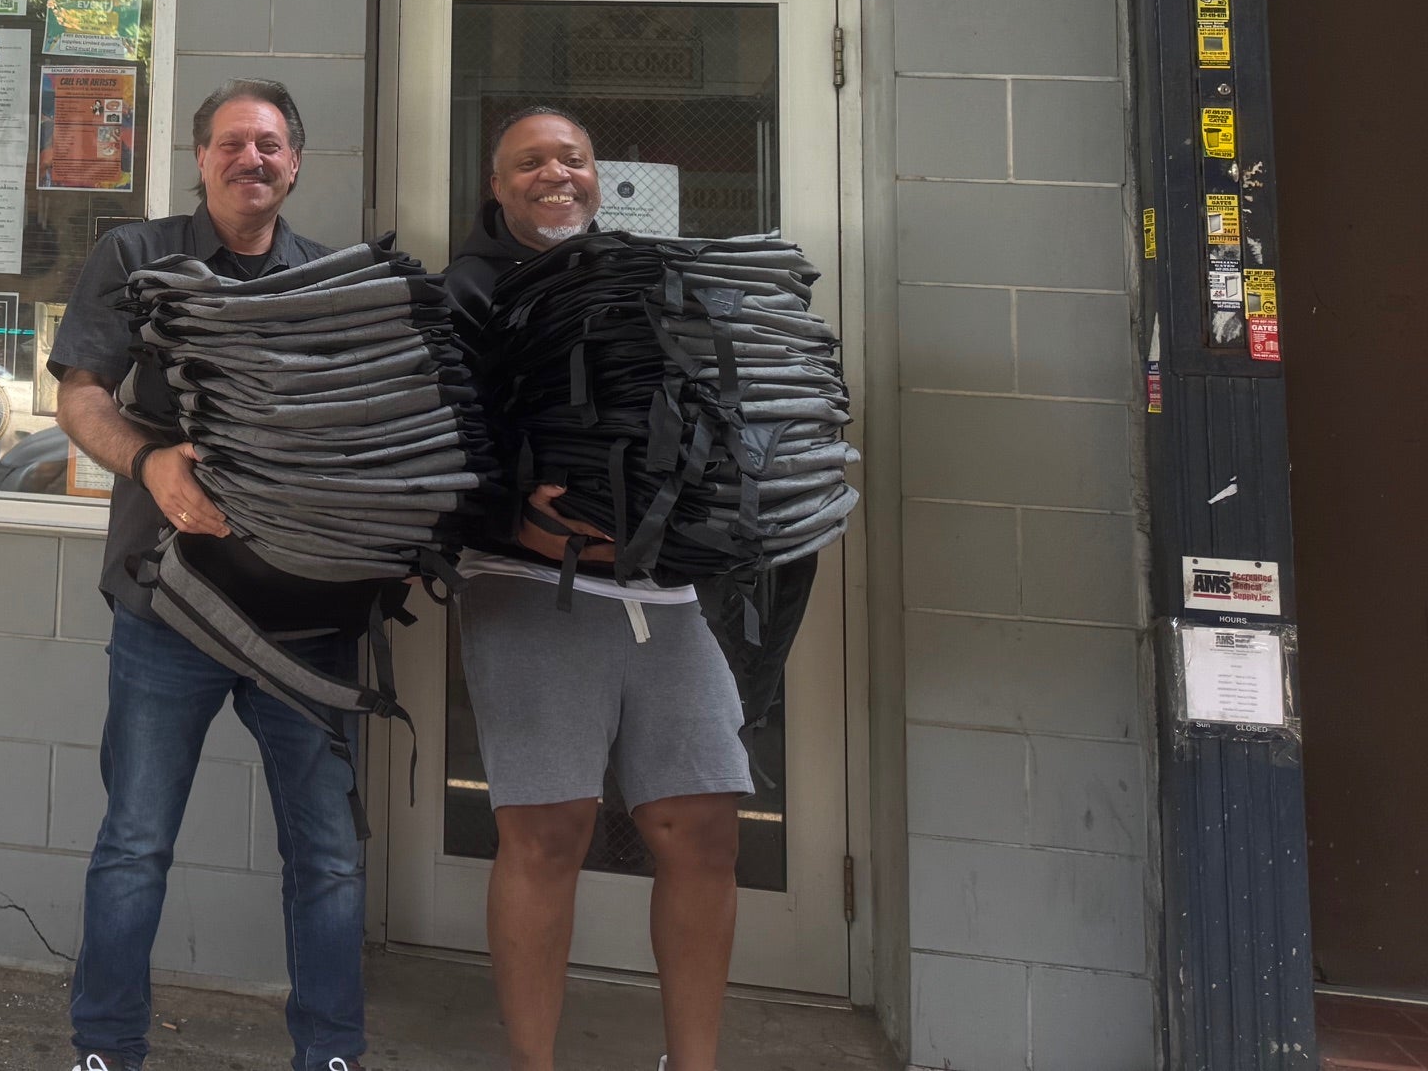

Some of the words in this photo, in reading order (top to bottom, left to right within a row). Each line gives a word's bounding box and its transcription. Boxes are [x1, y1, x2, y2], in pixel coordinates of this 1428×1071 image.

[1251, 324, 1278, 332] GATES
[1231, 572, 1272, 583] Accredited
[1193, 574, 1232, 595] AMS
[1219, 615, 1248, 625] HOURS
[1196, 721, 1211, 729] Sun
[1235, 724, 1268, 733] CLOSED
